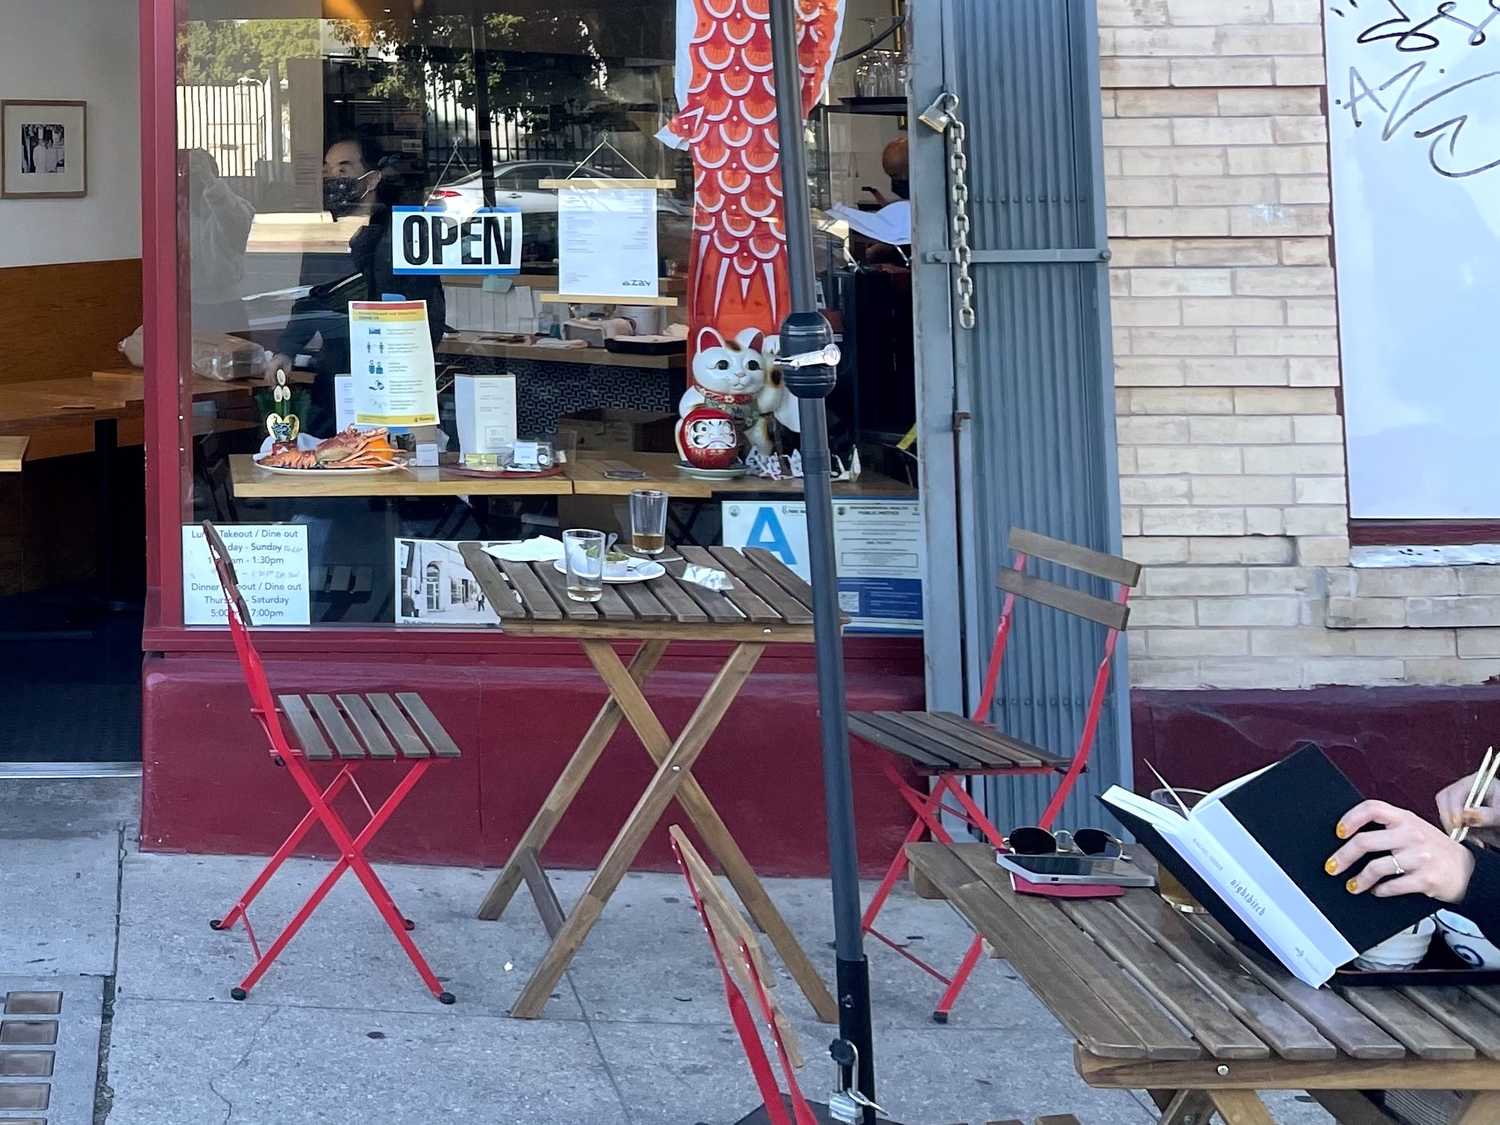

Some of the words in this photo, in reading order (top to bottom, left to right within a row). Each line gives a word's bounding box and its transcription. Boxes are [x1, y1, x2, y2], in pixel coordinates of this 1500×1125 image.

[401, 213, 513, 266] OPEN
[219, 529, 253, 538] Takeout
[261, 529, 282, 538] Dine
[283, 530, 299, 538] out
[746, 507, 798, 565] A
[250, 542, 283, 553] Sunday
[191, 582, 220, 591] Dinner
[264, 582, 285, 591] Dine
[286, 583, 302, 591] out
[251, 595, 290, 606] Saturday
[251, 608, 285, 619] 7:00pm
[1229, 878, 1267, 917] nightbitch
